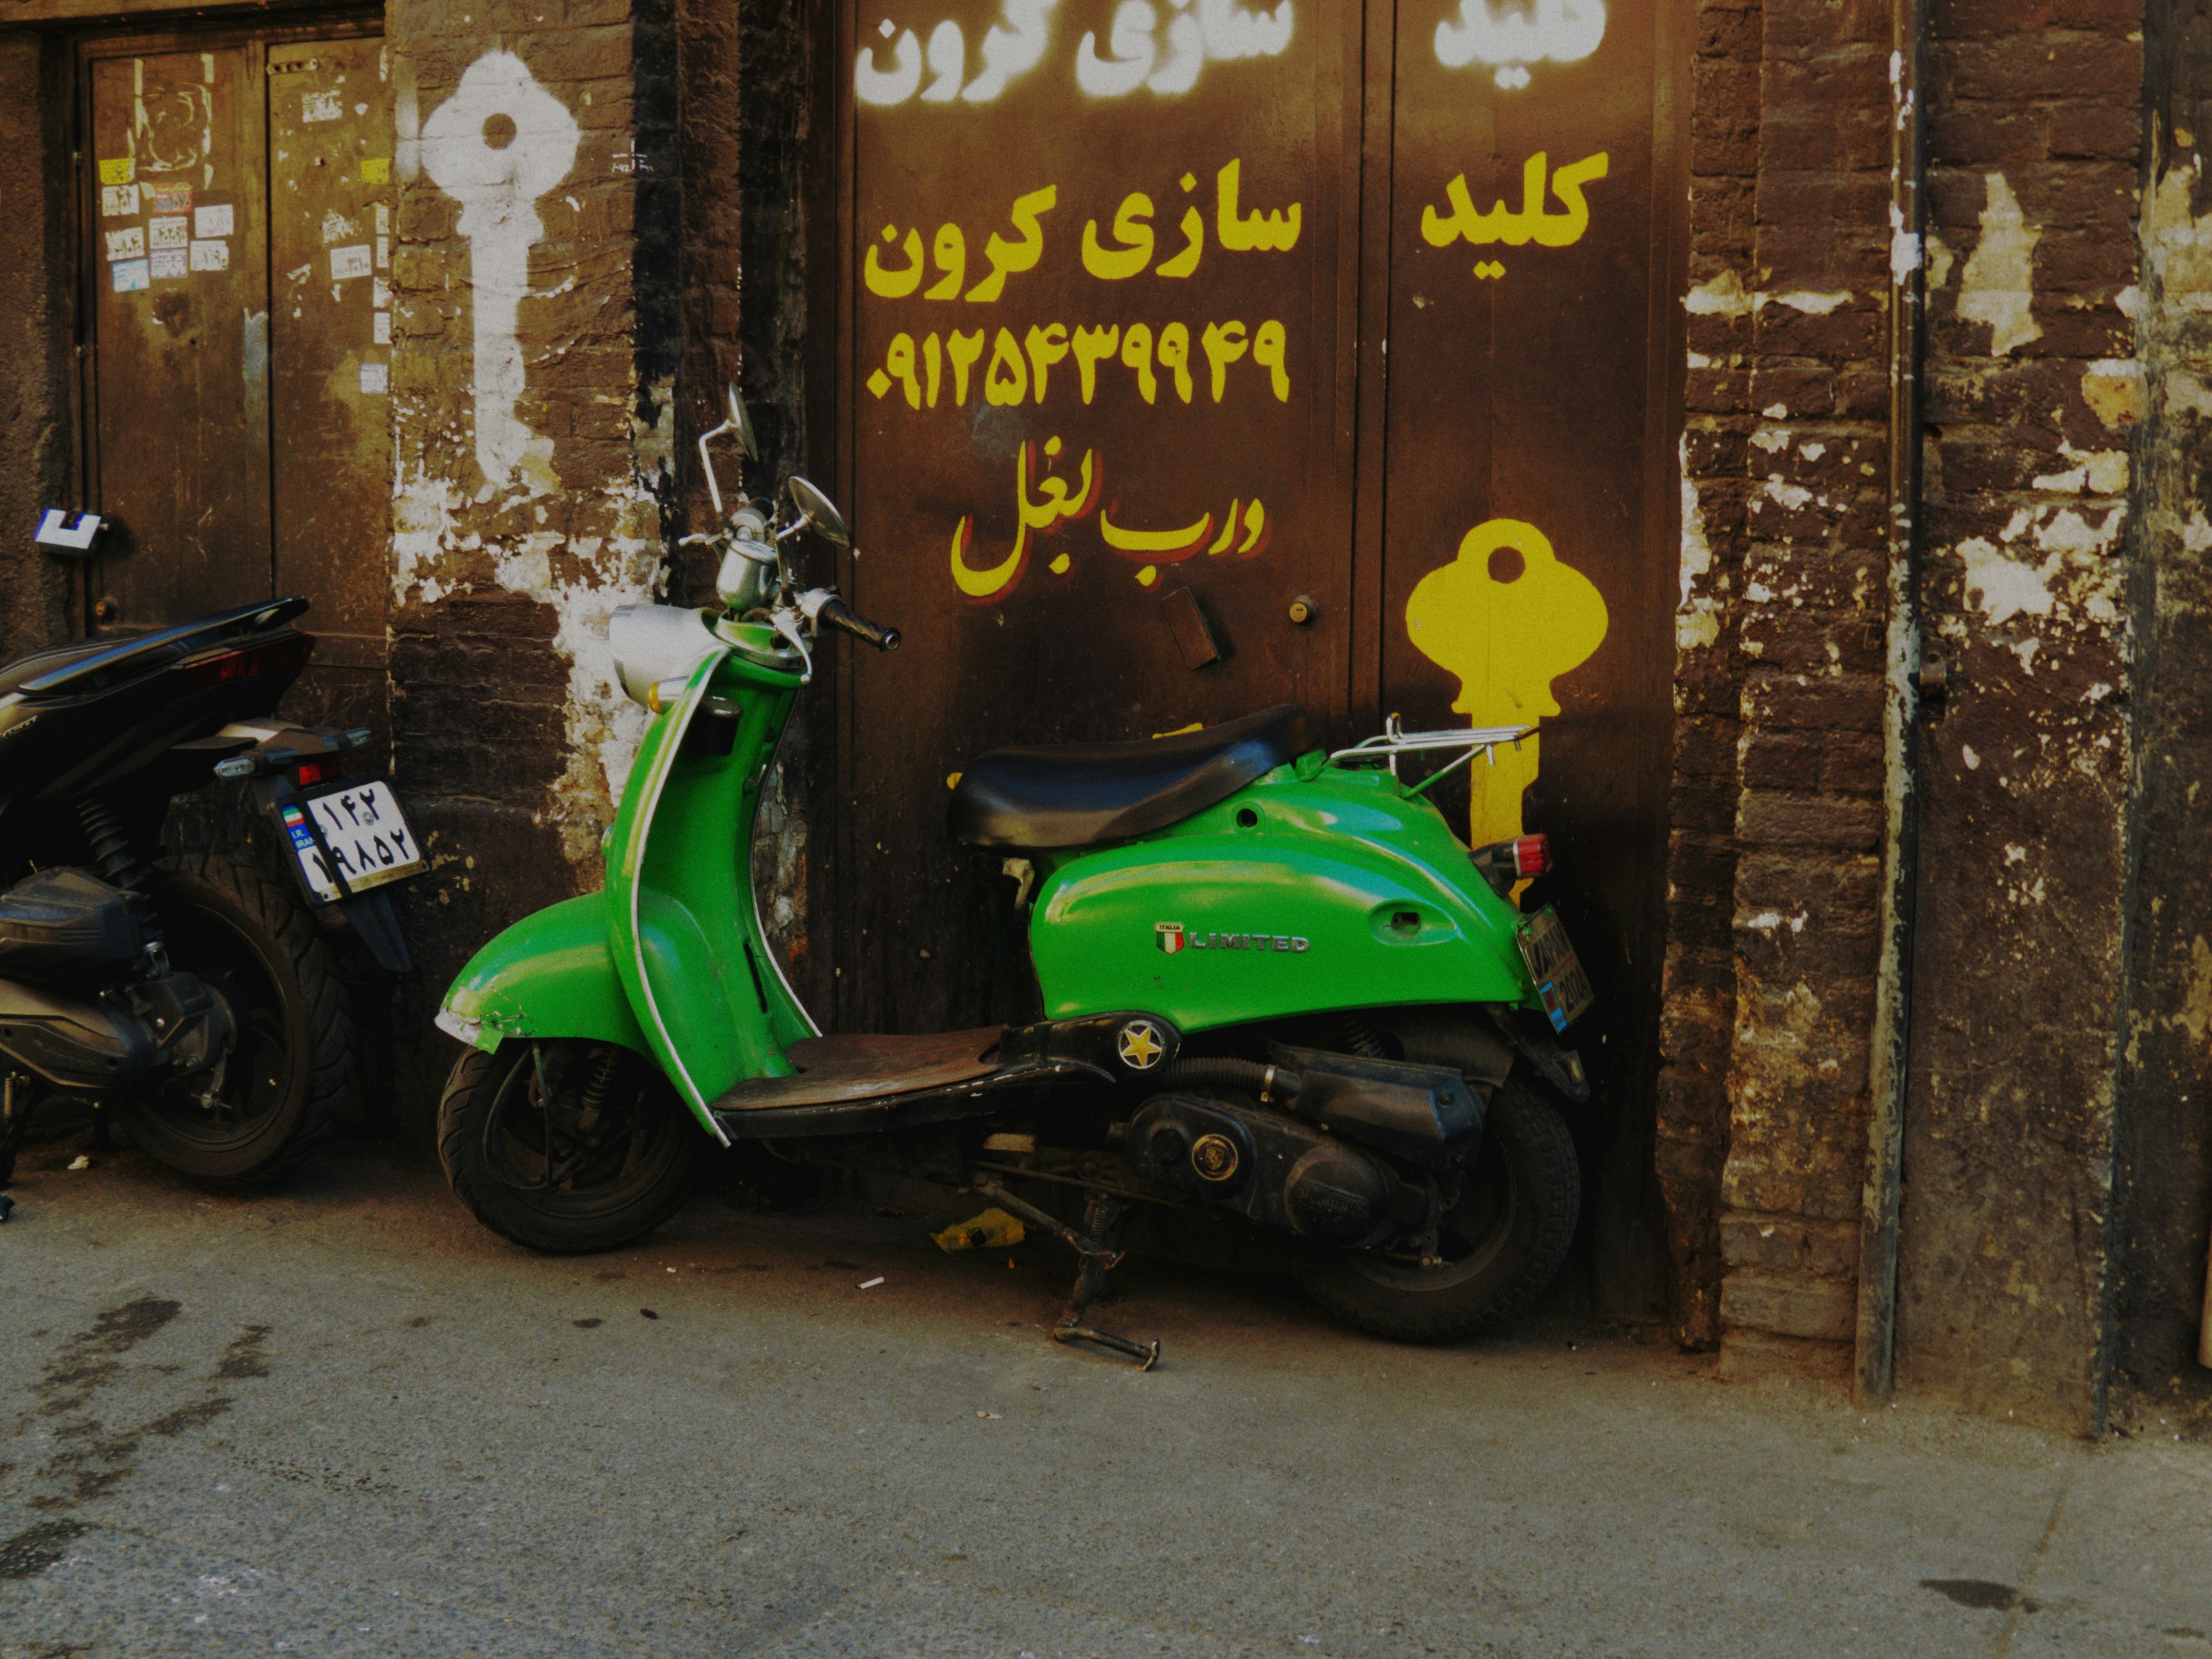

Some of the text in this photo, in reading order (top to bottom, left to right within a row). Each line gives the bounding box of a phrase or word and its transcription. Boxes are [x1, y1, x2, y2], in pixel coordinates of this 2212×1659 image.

[864, 151, 1609, 302] کلید سازی کرون
[866, 320, 1290, 410] ۰۹۱۲۵۴۳۹۹۴۹
[951, 436, 1265, 596] درب بغل
[322, 789, 380, 831] ۱۴۲
[312, 828, 410, 884] ۱۹۸۵۲
[1189, 931, 1311, 953] LIMITED
[1533, 921, 1571, 978] JAPAN
